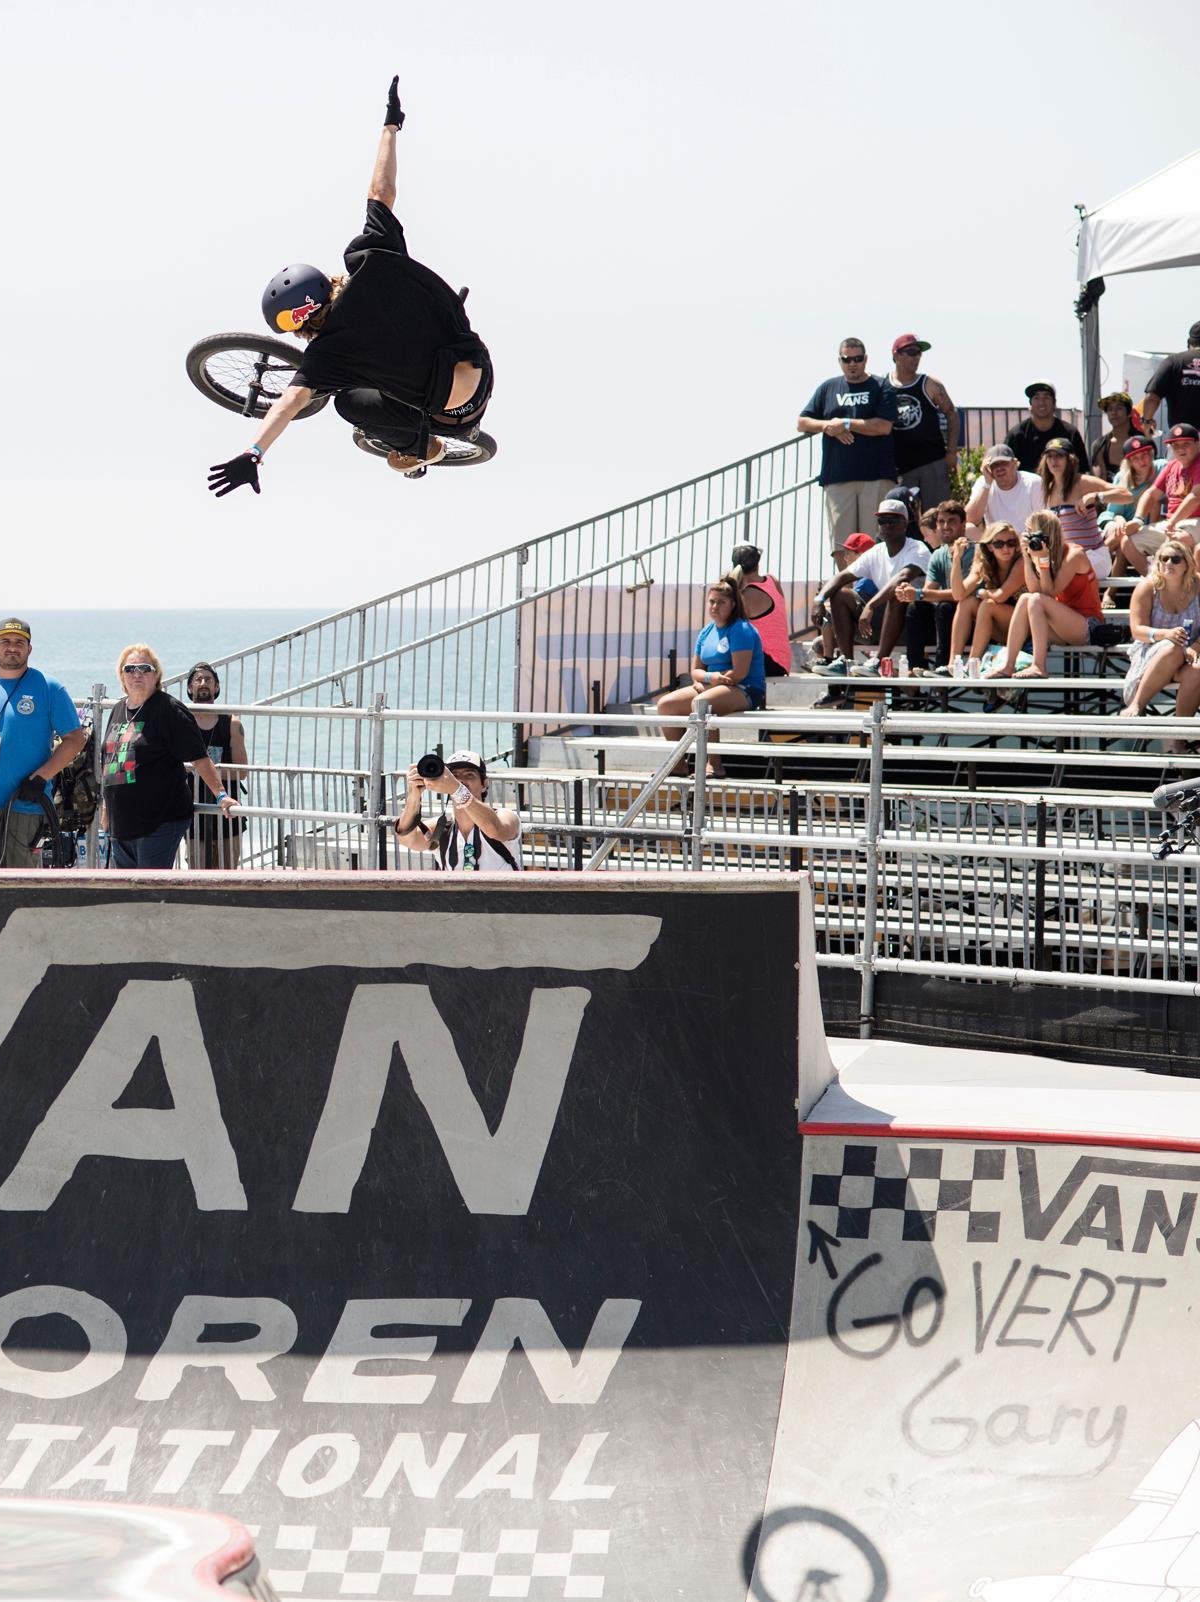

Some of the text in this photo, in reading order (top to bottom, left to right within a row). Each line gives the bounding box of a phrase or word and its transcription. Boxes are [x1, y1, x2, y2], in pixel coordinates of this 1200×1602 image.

[836, 392, 870, 407] VANS
[1016, 1147, 1200, 1257] VAN
[826, 1251, 1167, 1362] GO VERT
[900, 1357, 1128, 1480] Gary
